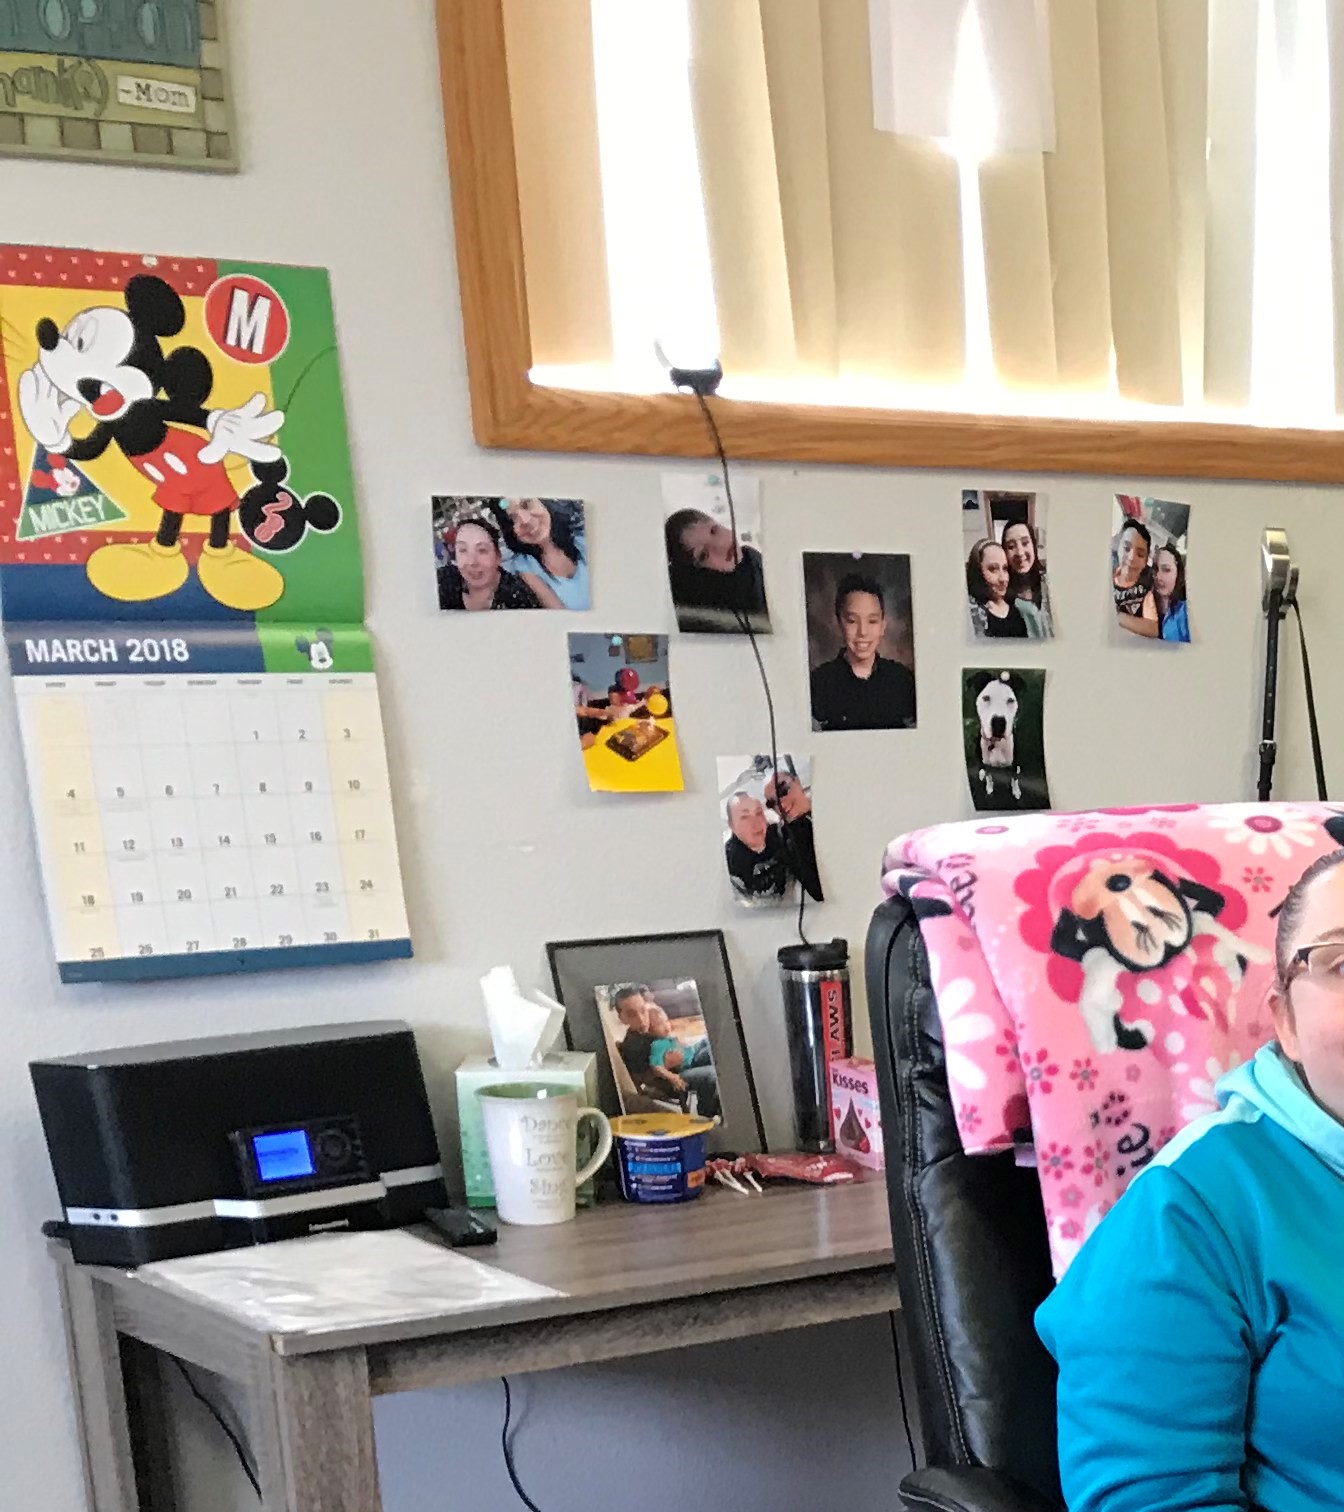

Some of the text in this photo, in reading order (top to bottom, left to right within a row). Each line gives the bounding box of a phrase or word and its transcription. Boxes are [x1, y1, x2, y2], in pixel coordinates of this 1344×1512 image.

[28, 494, 107, 534] MICKEY
[25, 638, 190, 664] MARCH 2018
